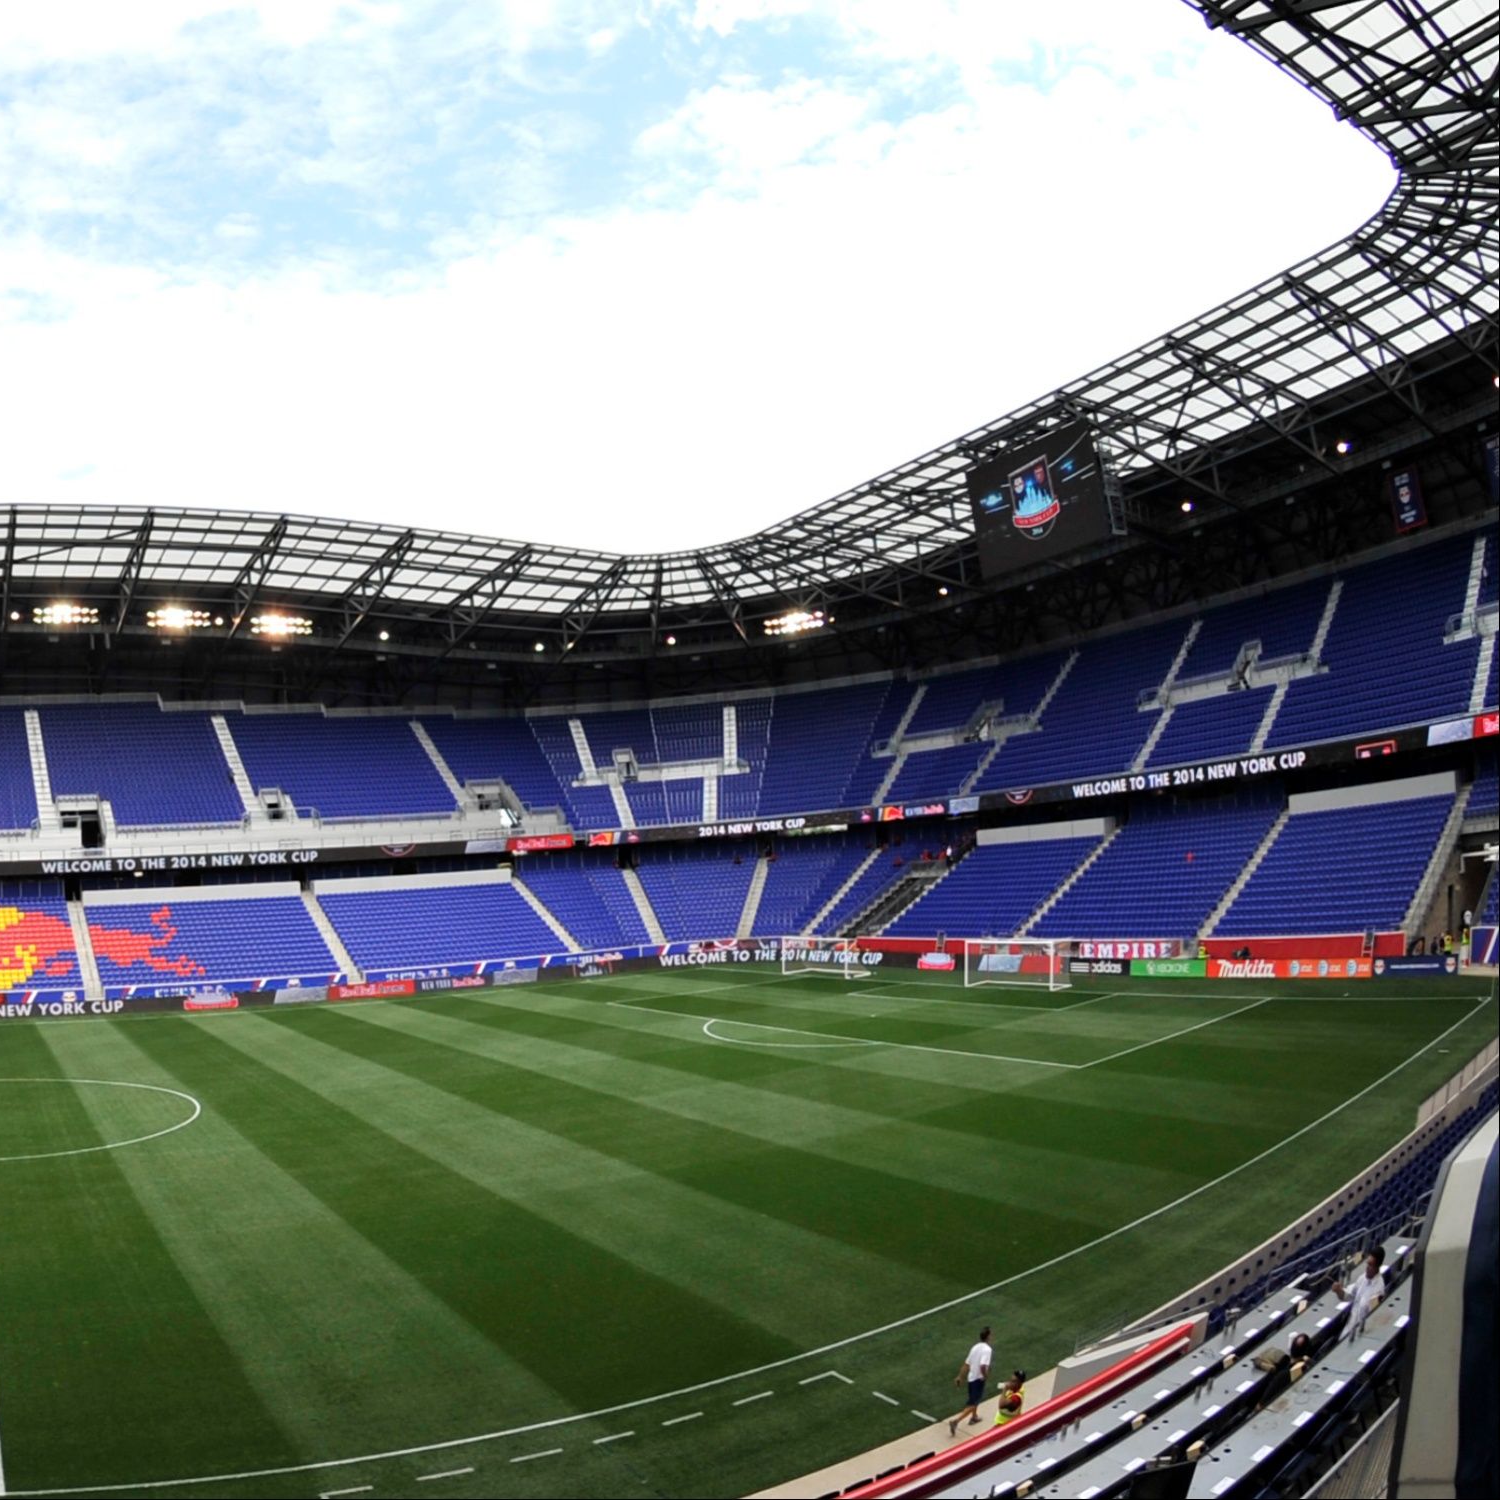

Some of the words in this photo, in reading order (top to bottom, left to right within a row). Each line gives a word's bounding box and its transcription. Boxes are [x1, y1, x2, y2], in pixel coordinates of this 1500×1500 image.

[1072, 779, 1127, 798] WELCOME
[1129, 776, 1145, 790] TO
[1148, 772, 1170, 788] THE
[1173, 767, 1204, 785] 2014
[1207, 764, 1237, 780] NEW
[1240, 757, 1276, 775] YORK
[1279, 751, 1306, 768] CUP
[699, 825, 725, 837] 2014
[728, 824, 753, 834] NEW
[755, 821, 783, 832] YORK
[785, 818, 806, 829] CUP
[41, 859, 112, 873] WELCOME
[116, 859, 136, 871] TO
[141, 857, 166, 869] THE
[171, 856, 207, 868] 2014
[211, 854, 244, 867] NEW
[250, 852, 286, 864] YORK
[291, 851, 318, 863] CUP
[660, 951, 727, 967] WELCOME
[732, 950, 750, 962] TO
[754, 949, 776, 961] THE
[808, 951, 832, 962] NEW
[833, 951, 860, 964] YORK
[861, 952, 883, 965] CUP
[1083, 942, 1172, 958] EMPIRE
[38, 1002, 86, 1015] YORK
[91, 1000, 124, 1013] CUP
